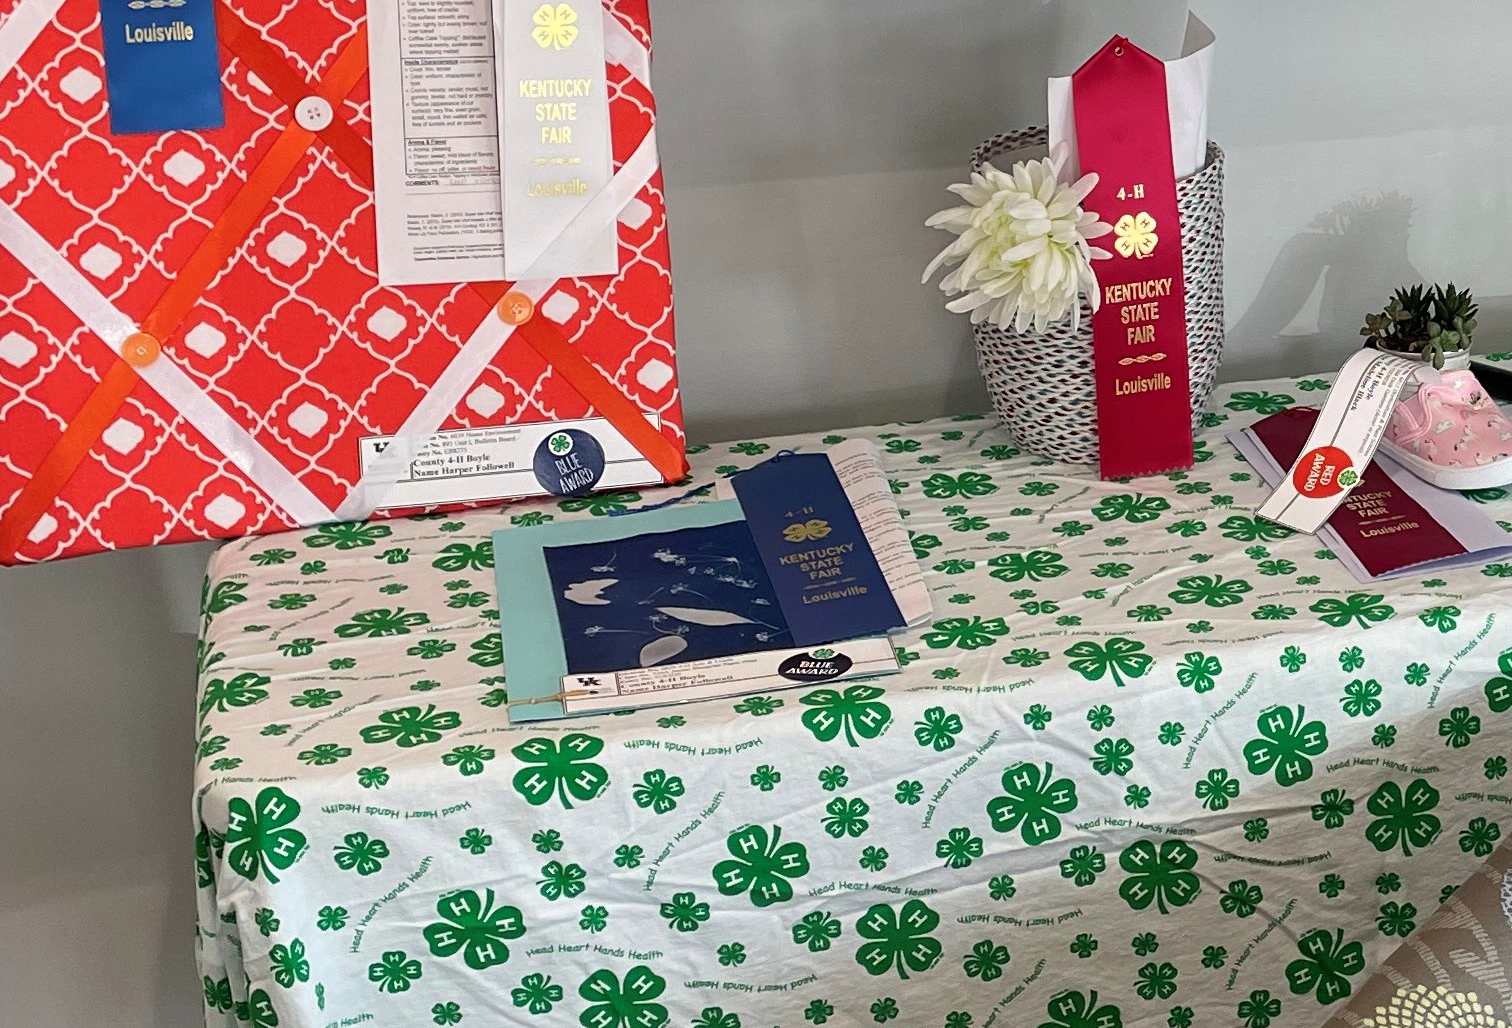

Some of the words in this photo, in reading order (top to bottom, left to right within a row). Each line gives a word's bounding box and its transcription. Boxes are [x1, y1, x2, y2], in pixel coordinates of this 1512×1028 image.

[125, 21, 194, 43] Louisville
[519, 79, 592, 98] KENTUCKY
[535, 102, 577, 122] STATE
[541, 126, 572, 145] FAIR
[527, 179, 588, 198] Louisville
[1116, 184, 1145, 201] 4-H
[1105, 277, 1173, 305] KENTUCKY
[1121, 302, 1160, 325] STATE
[1127, 324, 1156, 346] FAIR
[1115, 372, 1171, 396] Louisville
[1350, 391, 1365, 412] Black
[413, 459, 445, 468] County
[467, 453, 491, 462] Boyle
[555, 452, 583, 475] BLUE
[414, 469, 439, 477] Name
[441, 466, 474, 476] Harper
[559, 467, 594, 494] AWARD
[1304, 453, 1325, 492] AWARD
[1319, 465, 1336, 486] RED
[1341, 491, 1392, 504] NTUCKY
[1346, 499, 1388, 511] STATE
[1358, 507, 1390, 518] FAIR
[1360, 521, 1420, 538] Louisville
[779, 542, 854, 566] KENTUCKY
[799, 556, 844, 572] STATE
[808, 567, 843, 580] FAIR
[802, 585, 868, 605] Louisville
[785, 667, 839, 675] AWARD
[800, 660, 835, 668] BLUE
[1182, 746, 1196, 769] Head
[1193, 719, 1212, 744] Heart
[1210, 698, 1237, 721] Hands
[1234, 671, 1258, 701] Health
[921, 804, 933, 829] Head
[929, 777, 953, 804] Heart
[952, 752, 979, 780] Hands
[976, 729, 1002, 755] Health
[643, 867, 657, 892] Head
[652, 842, 675, 866] Heart
[674, 817, 702, 842] Hands
[699, 790, 726, 819] Health
[350, 932, 361, 953] Head
[360, 901, 381, 927] Heart
[382, 880, 409, 904] Hands
[408, 854, 433, 882] Health
[525, 944, 554, 957] Head
[558, 942, 590, 953] Heart
[593, 945, 624, 958] Hands
[627, 948, 664, 960] Health
